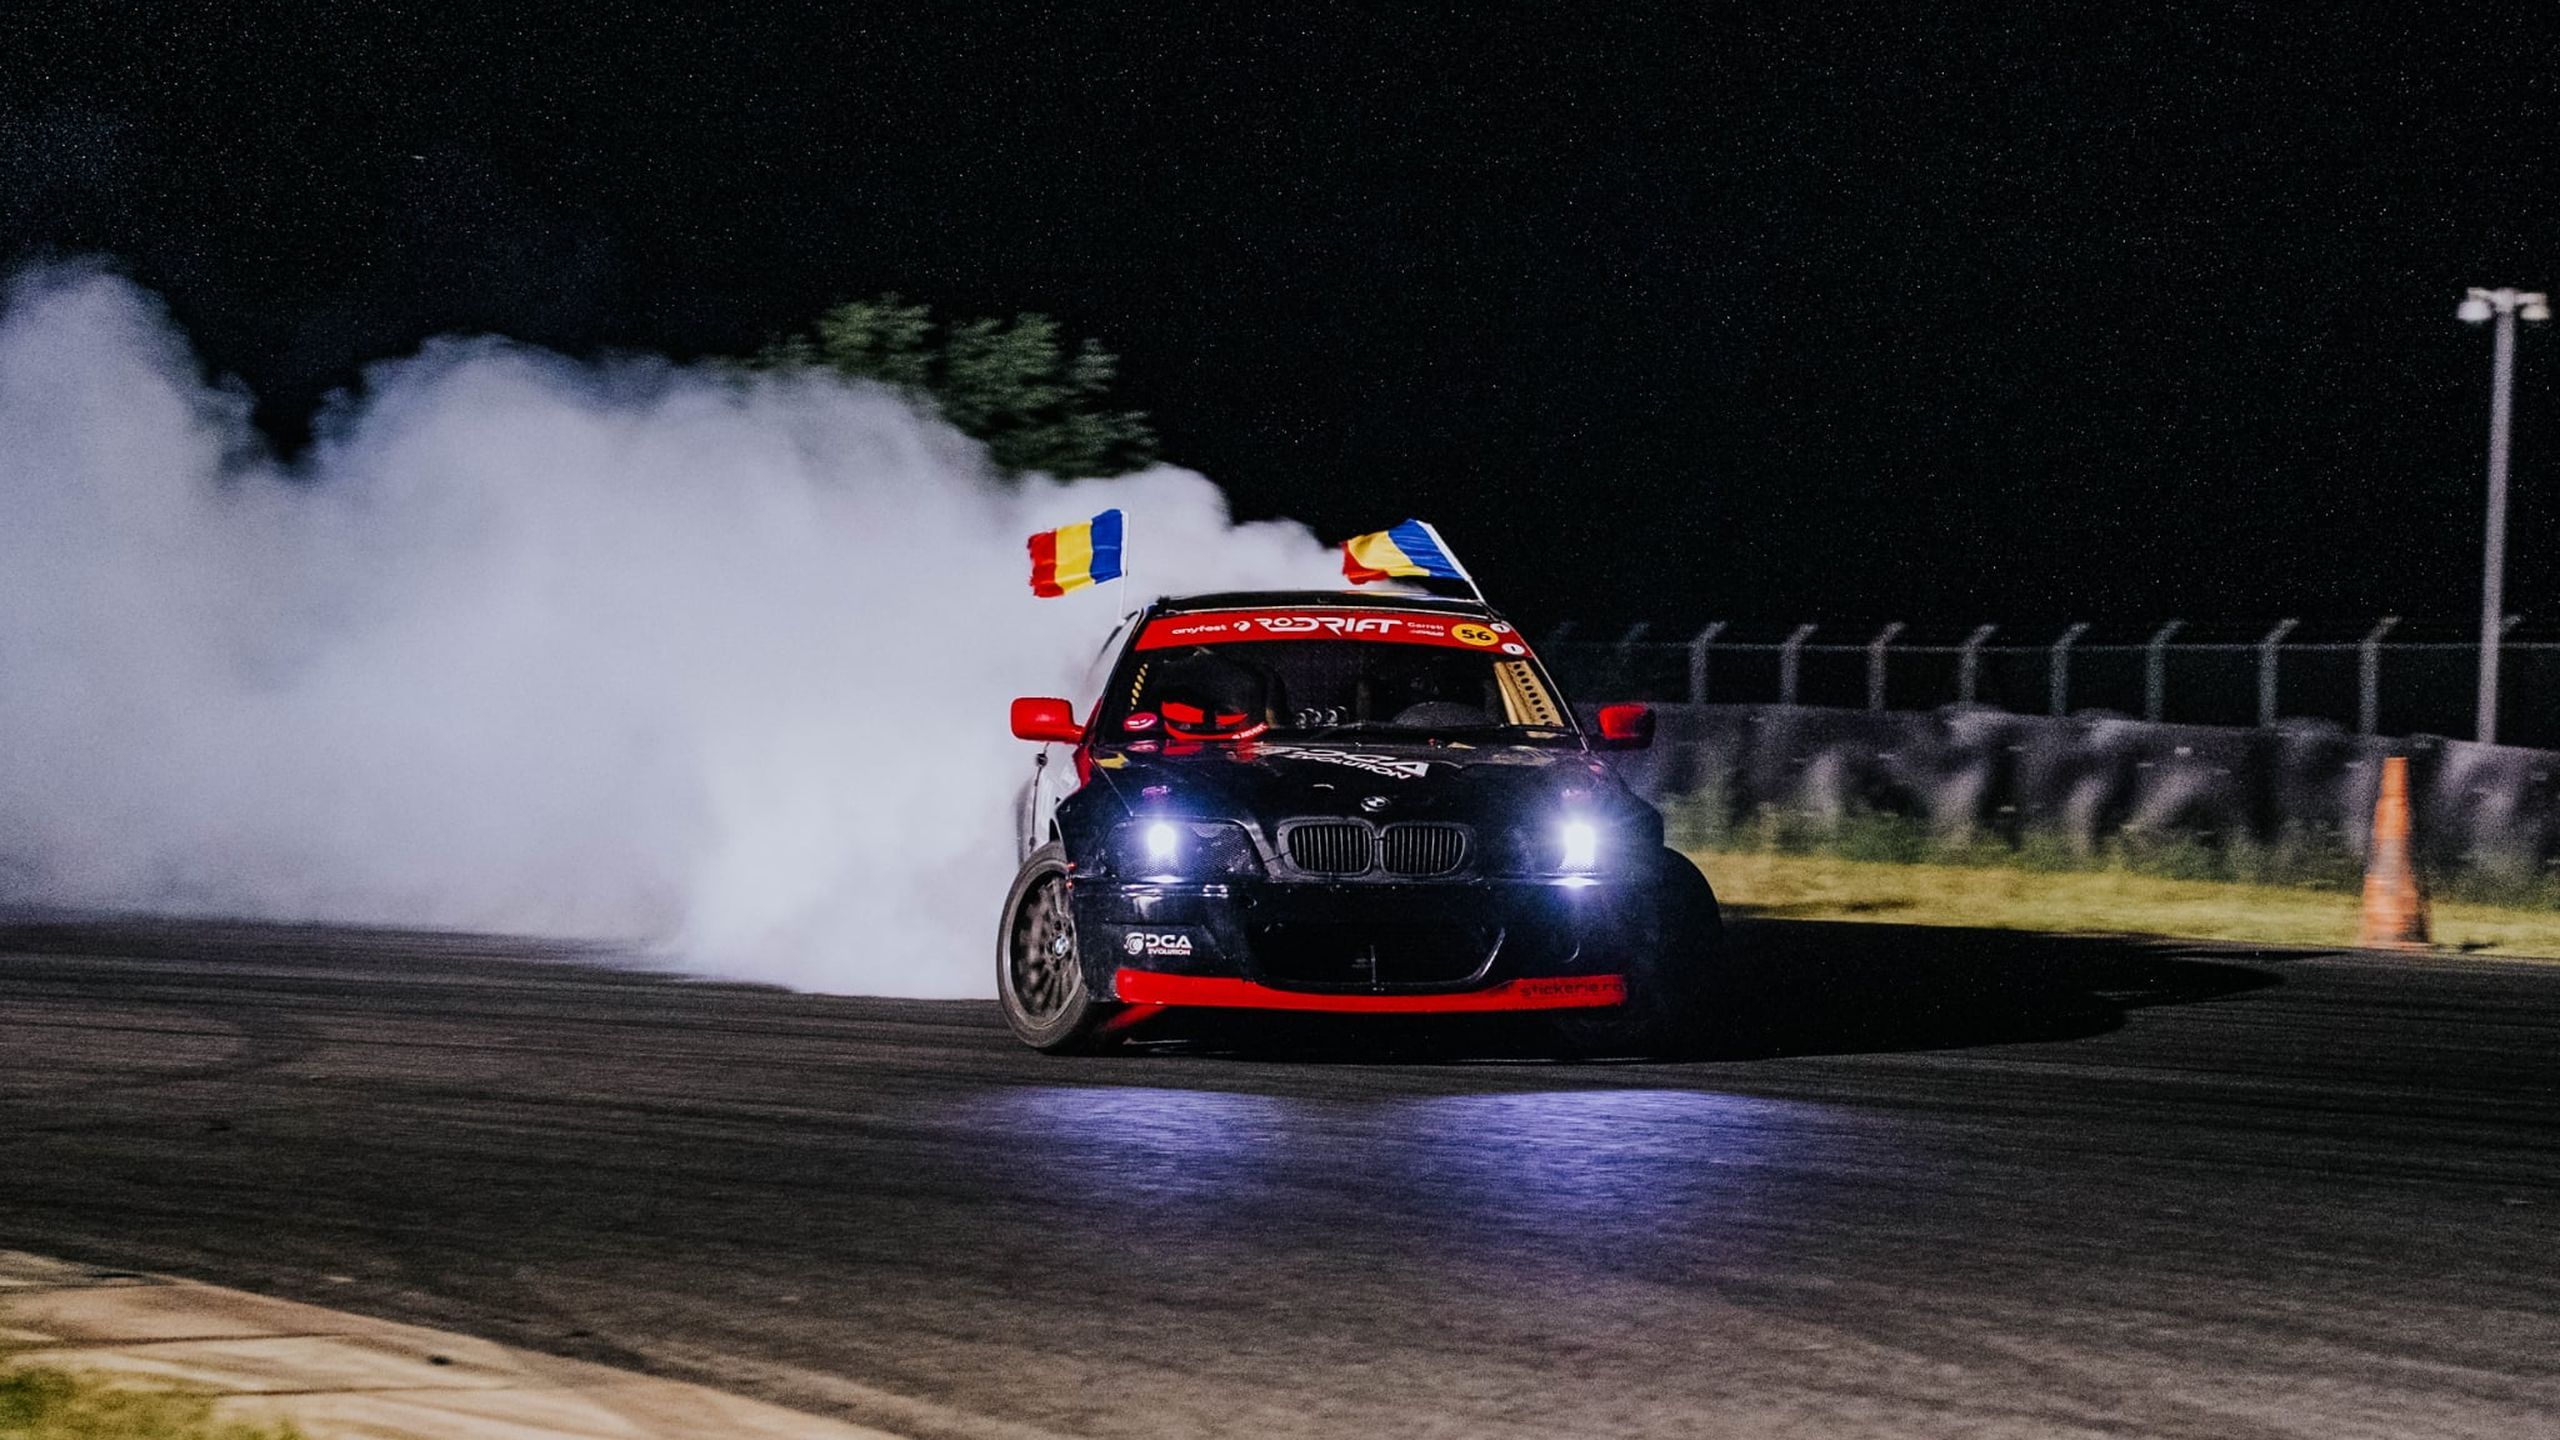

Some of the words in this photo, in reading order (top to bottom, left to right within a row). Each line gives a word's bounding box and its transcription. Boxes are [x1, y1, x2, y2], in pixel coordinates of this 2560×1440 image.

[1461, 629, 1491, 641] 56
[1145, 933, 1193, 949] DCA
[1148, 947, 1191, 956] EVOLUTION
